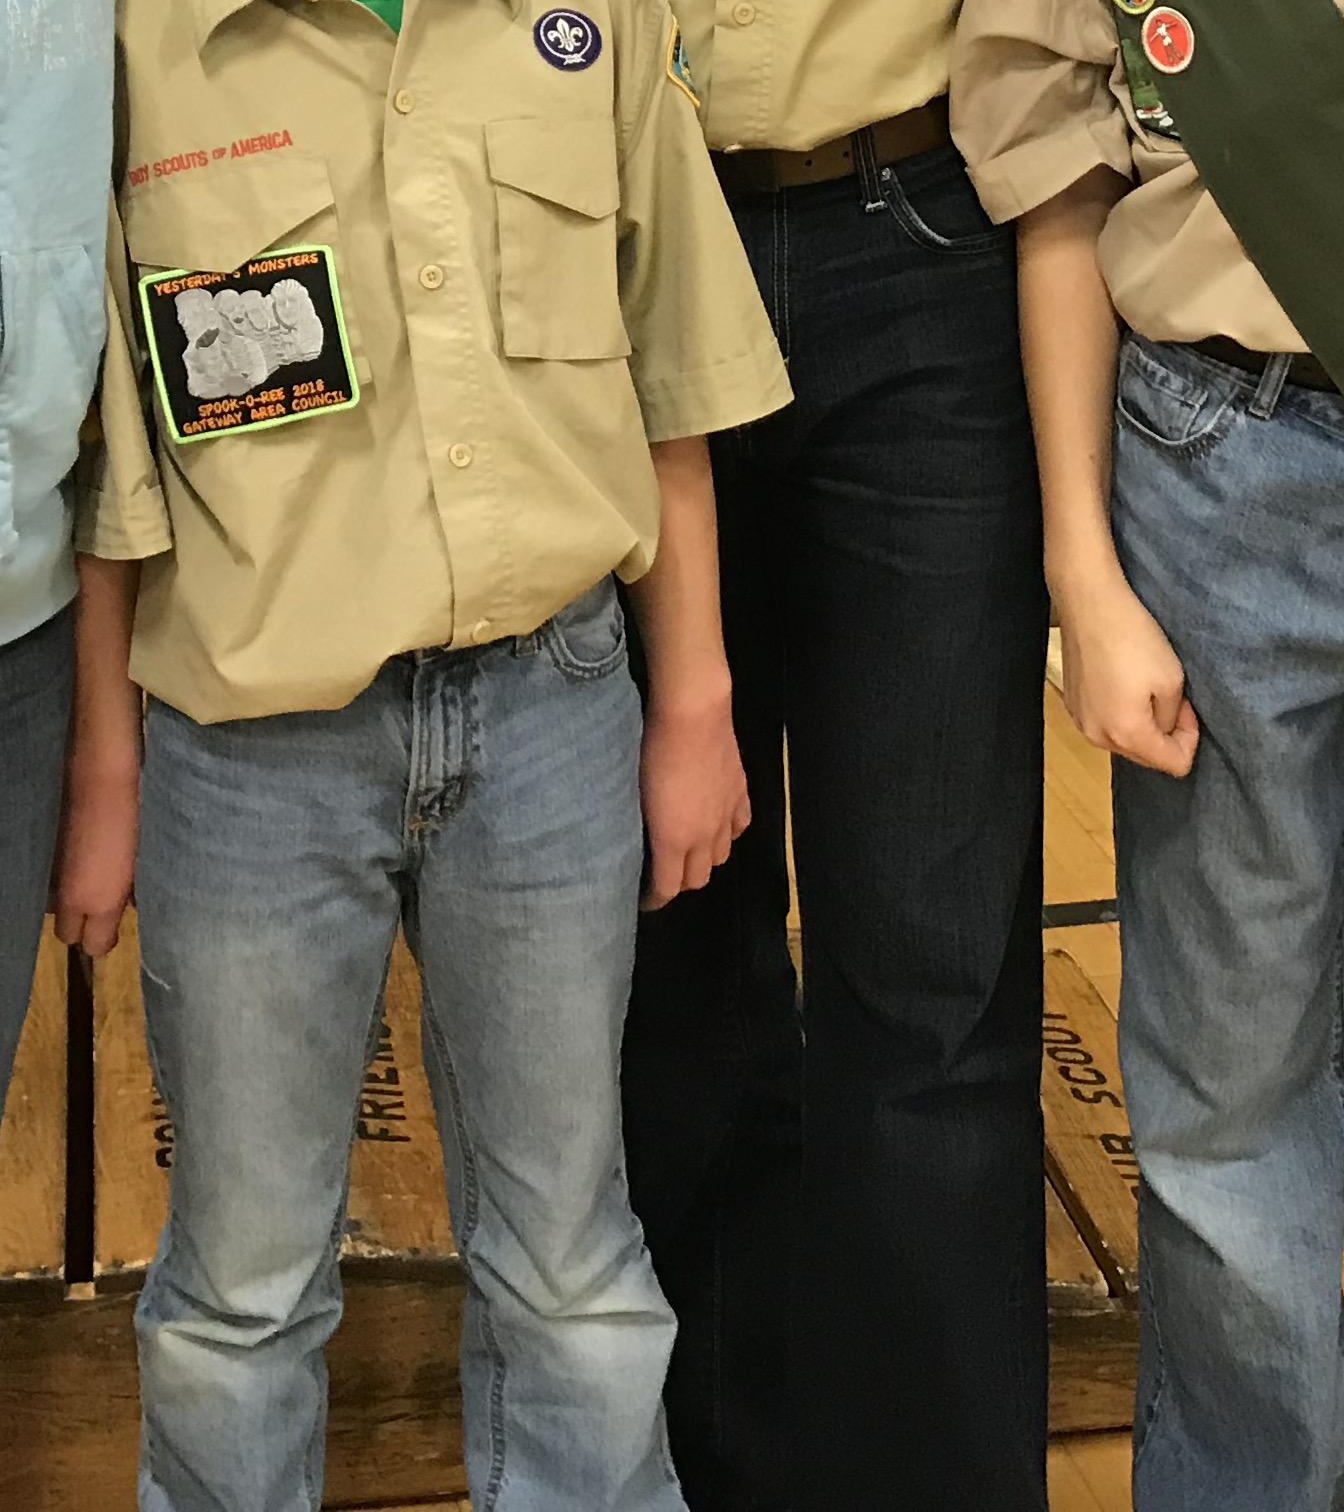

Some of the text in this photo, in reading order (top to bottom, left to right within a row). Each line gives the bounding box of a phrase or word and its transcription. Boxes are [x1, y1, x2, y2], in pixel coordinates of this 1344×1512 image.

[128, 164, 149, 186] BOY
[152, 150, 209, 178] SCOUTS
[230, 129, 293, 159] AMERICA
[248, 252, 319, 276] MONSTERS
[182, 391, 347, 434] GATEWAY AREA COUNCIL
[197, 387, 286, 419] SPOOK-O-REE
